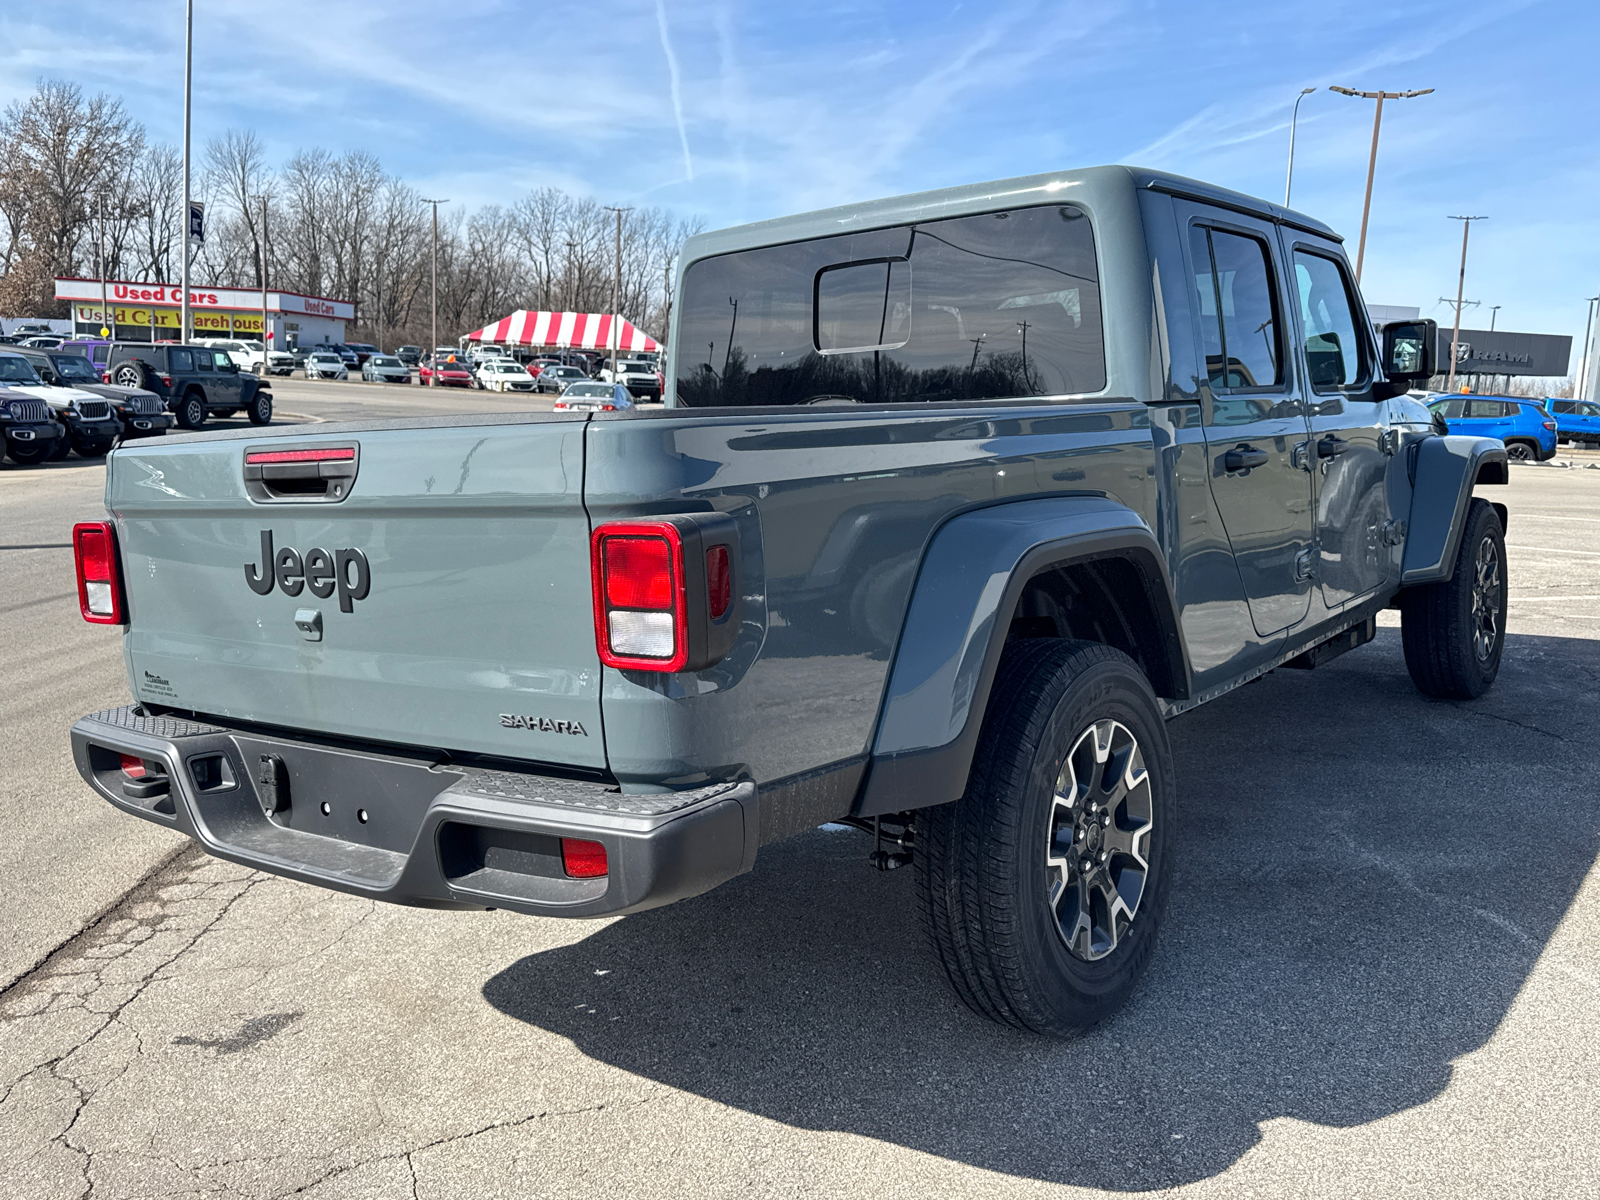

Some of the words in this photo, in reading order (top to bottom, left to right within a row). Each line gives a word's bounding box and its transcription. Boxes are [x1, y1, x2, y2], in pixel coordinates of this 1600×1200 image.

[114, 284, 166, 301] Used
[170, 289, 219, 305] Cars
[79, 307, 127, 323] Used
[131, 310, 168, 326] Car
[304, 299, 321, 313] Used
[321, 302, 335, 316] Cars
[1472, 349, 1530, 363] RAM
[244, 529, 371, 613] Jeep
[499, 713, 588, 737] SAHARA
